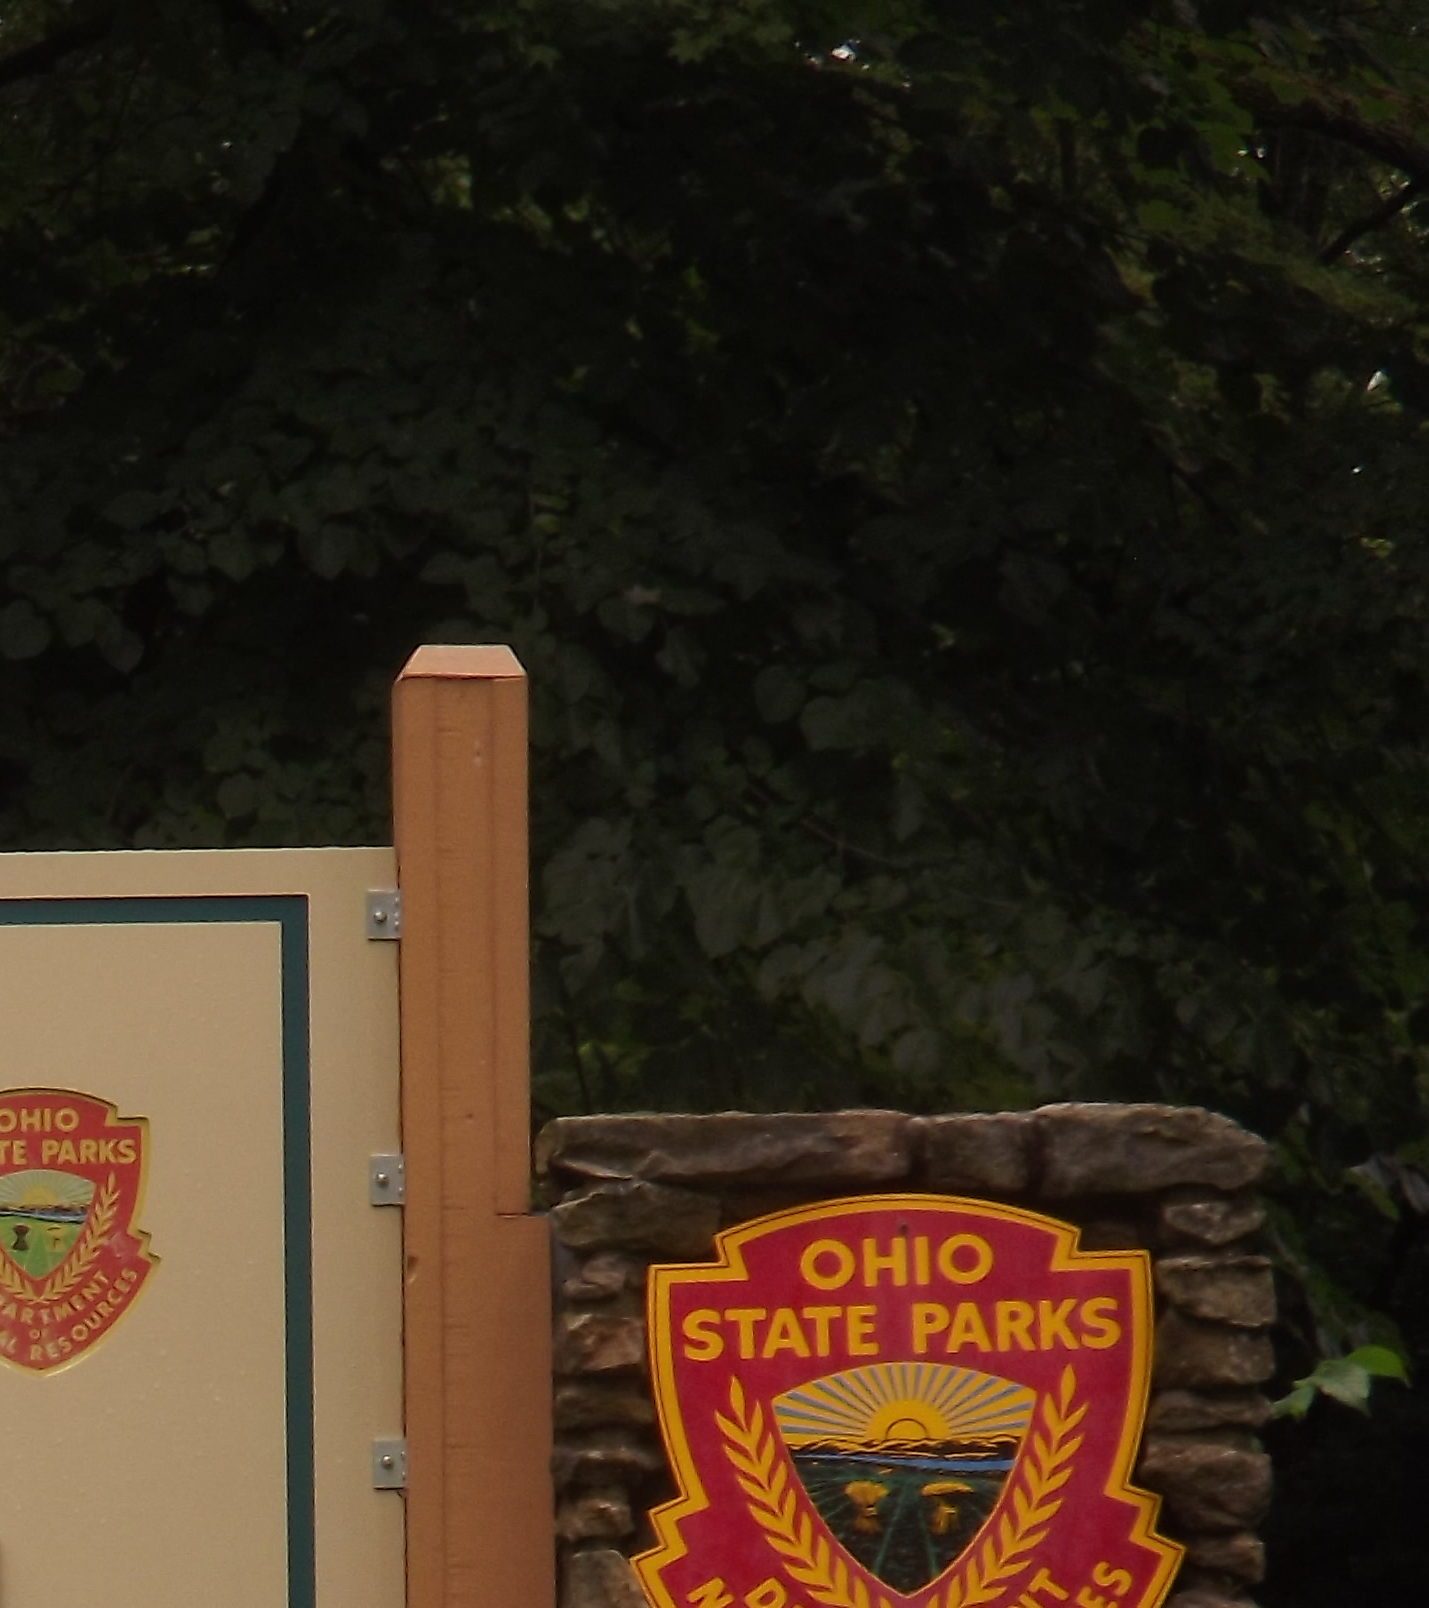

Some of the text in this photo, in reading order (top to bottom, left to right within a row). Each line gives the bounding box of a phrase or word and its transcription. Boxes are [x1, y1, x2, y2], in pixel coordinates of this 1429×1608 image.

[42, 1138, 138, 1166] PARKS
[800, 1233, 994, 1290] OHIO
[29, 1267, 139, 1361] RESOURCES
[681, 1297, 1122, 1362] STATE PARKS
